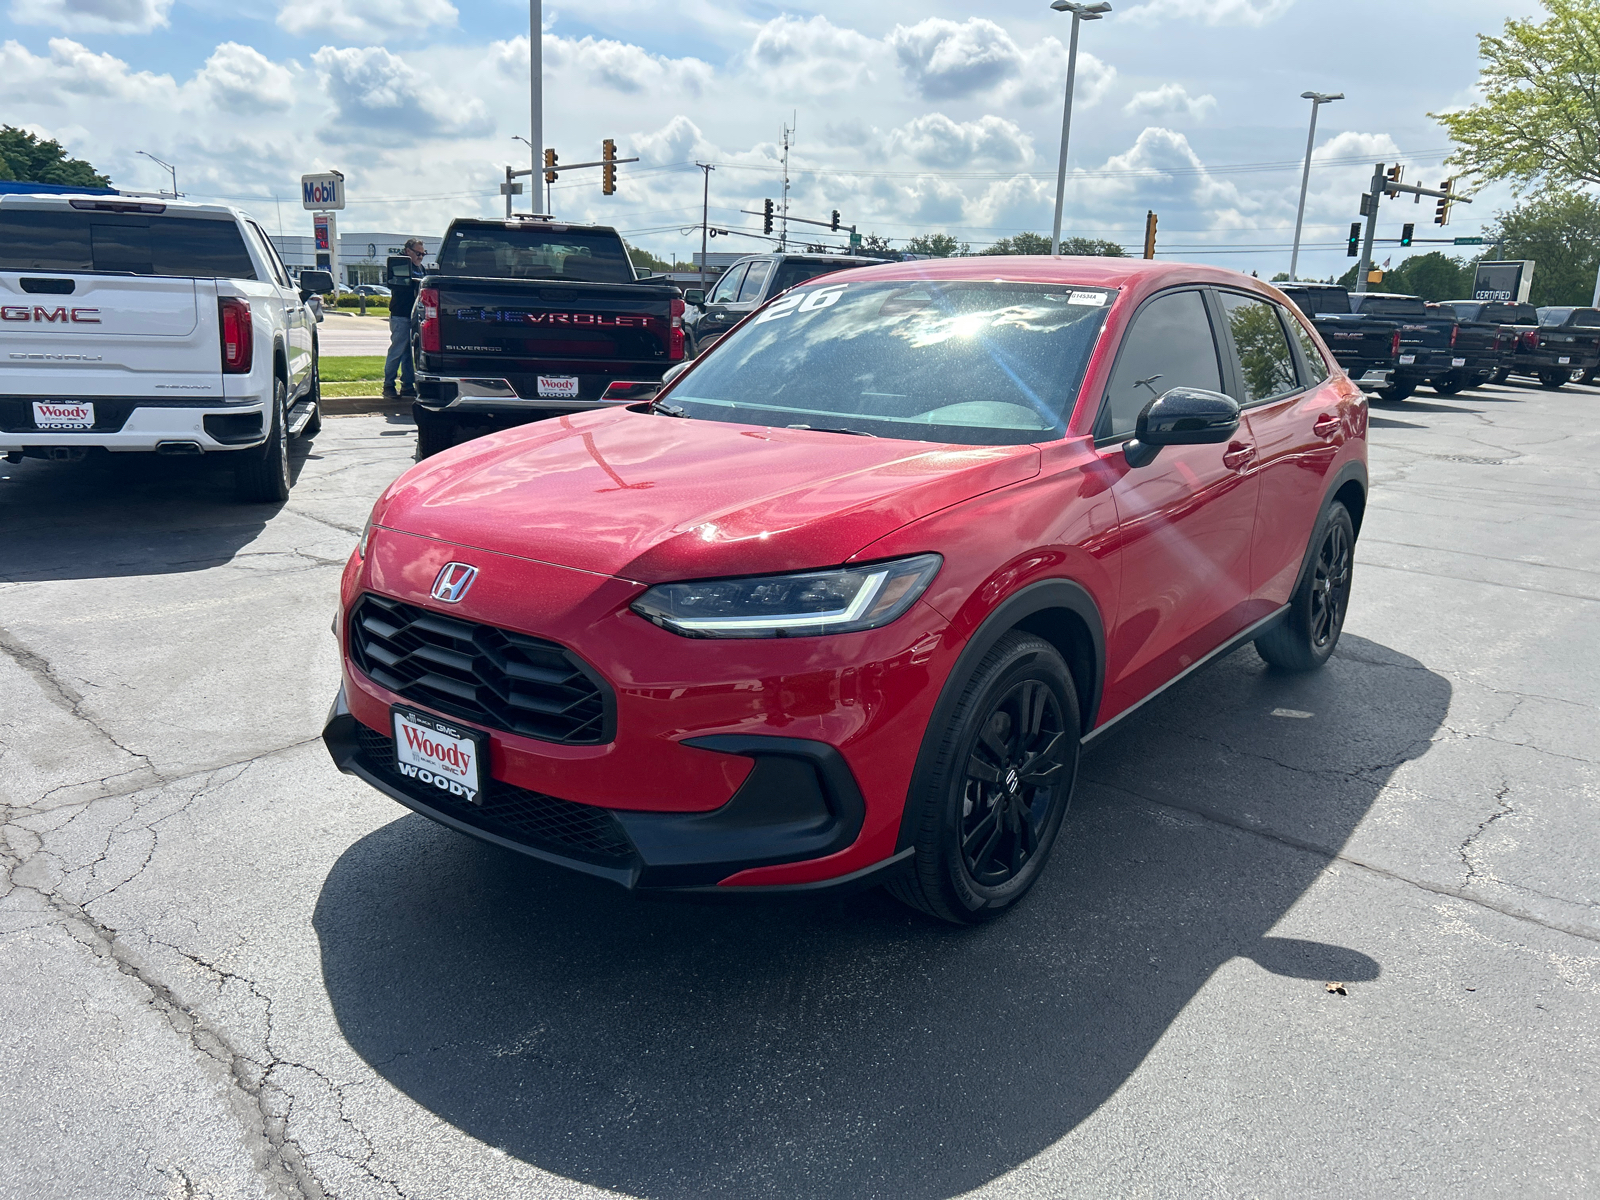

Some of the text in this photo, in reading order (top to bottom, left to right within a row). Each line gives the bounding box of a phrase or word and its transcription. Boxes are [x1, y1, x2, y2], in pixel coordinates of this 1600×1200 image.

[304, 180, 336, 203] Mobil
[1475, 290, 1511, 300] CERTIFIED
[754, 283, 849, 326] 26
[0, 305, 102, 324] GMC
[457, 309, 655, 327] CHEVROLET
[445, 344, 502, 352] SILVERADO
[9, 352, 103, 361] DENALI
[540, 379, 575, 391] Woody
[37, 405, 89, 420] Woody
[435, 723, 457, 736] GMC
[401, 723, 472, 776] Woody
[441, 764, 460, 776] GMC
[398, 761, 477, 802] WOODY
